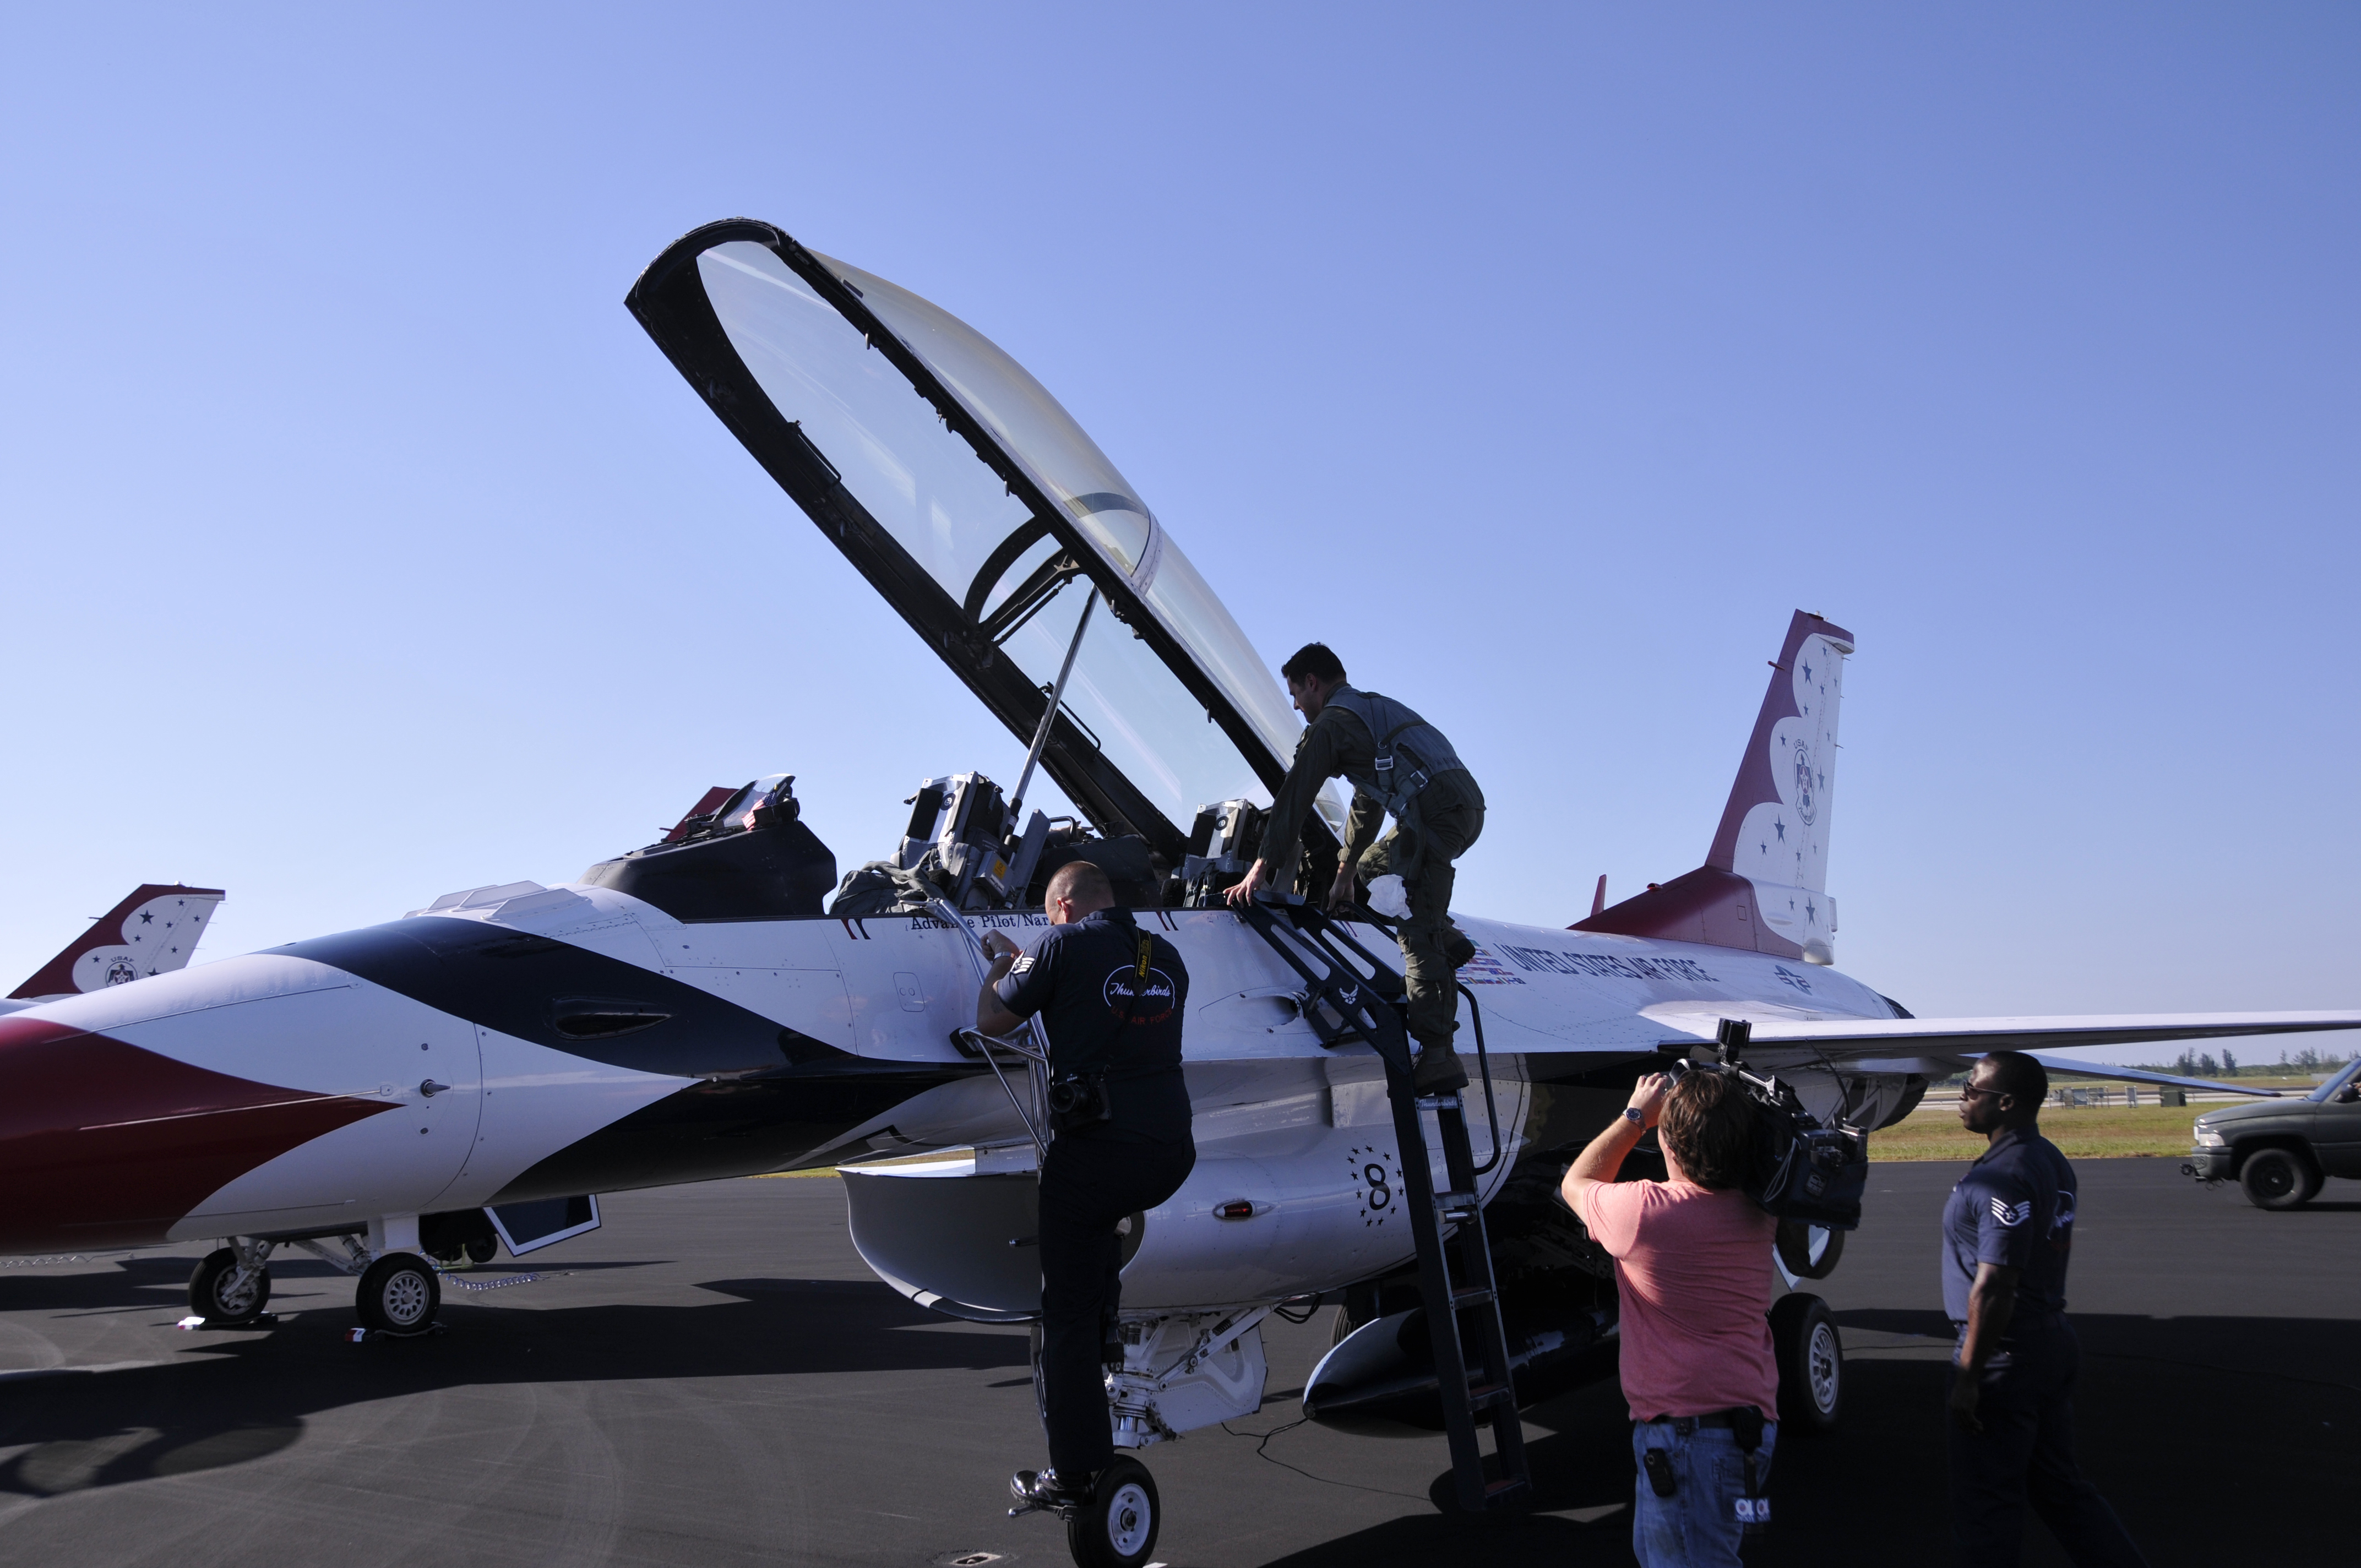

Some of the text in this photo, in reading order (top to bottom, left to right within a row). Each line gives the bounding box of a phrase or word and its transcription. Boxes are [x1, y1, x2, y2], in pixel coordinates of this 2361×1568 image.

[911, 914, 1048, 930] Advae Pilot/Nar
[1139, 955, 1147, 977] Nikon
[1493, 943, 1720, 982] UNITED STATES AIR FORCE
[1109, 982, 1171, 997] Thunrbirds
[1131, 1016, 1146, 1025] AIR
[1419, 1097, 1457, 1107] Thunderbirds
[1363, 1163, 1391, 1211] 8
